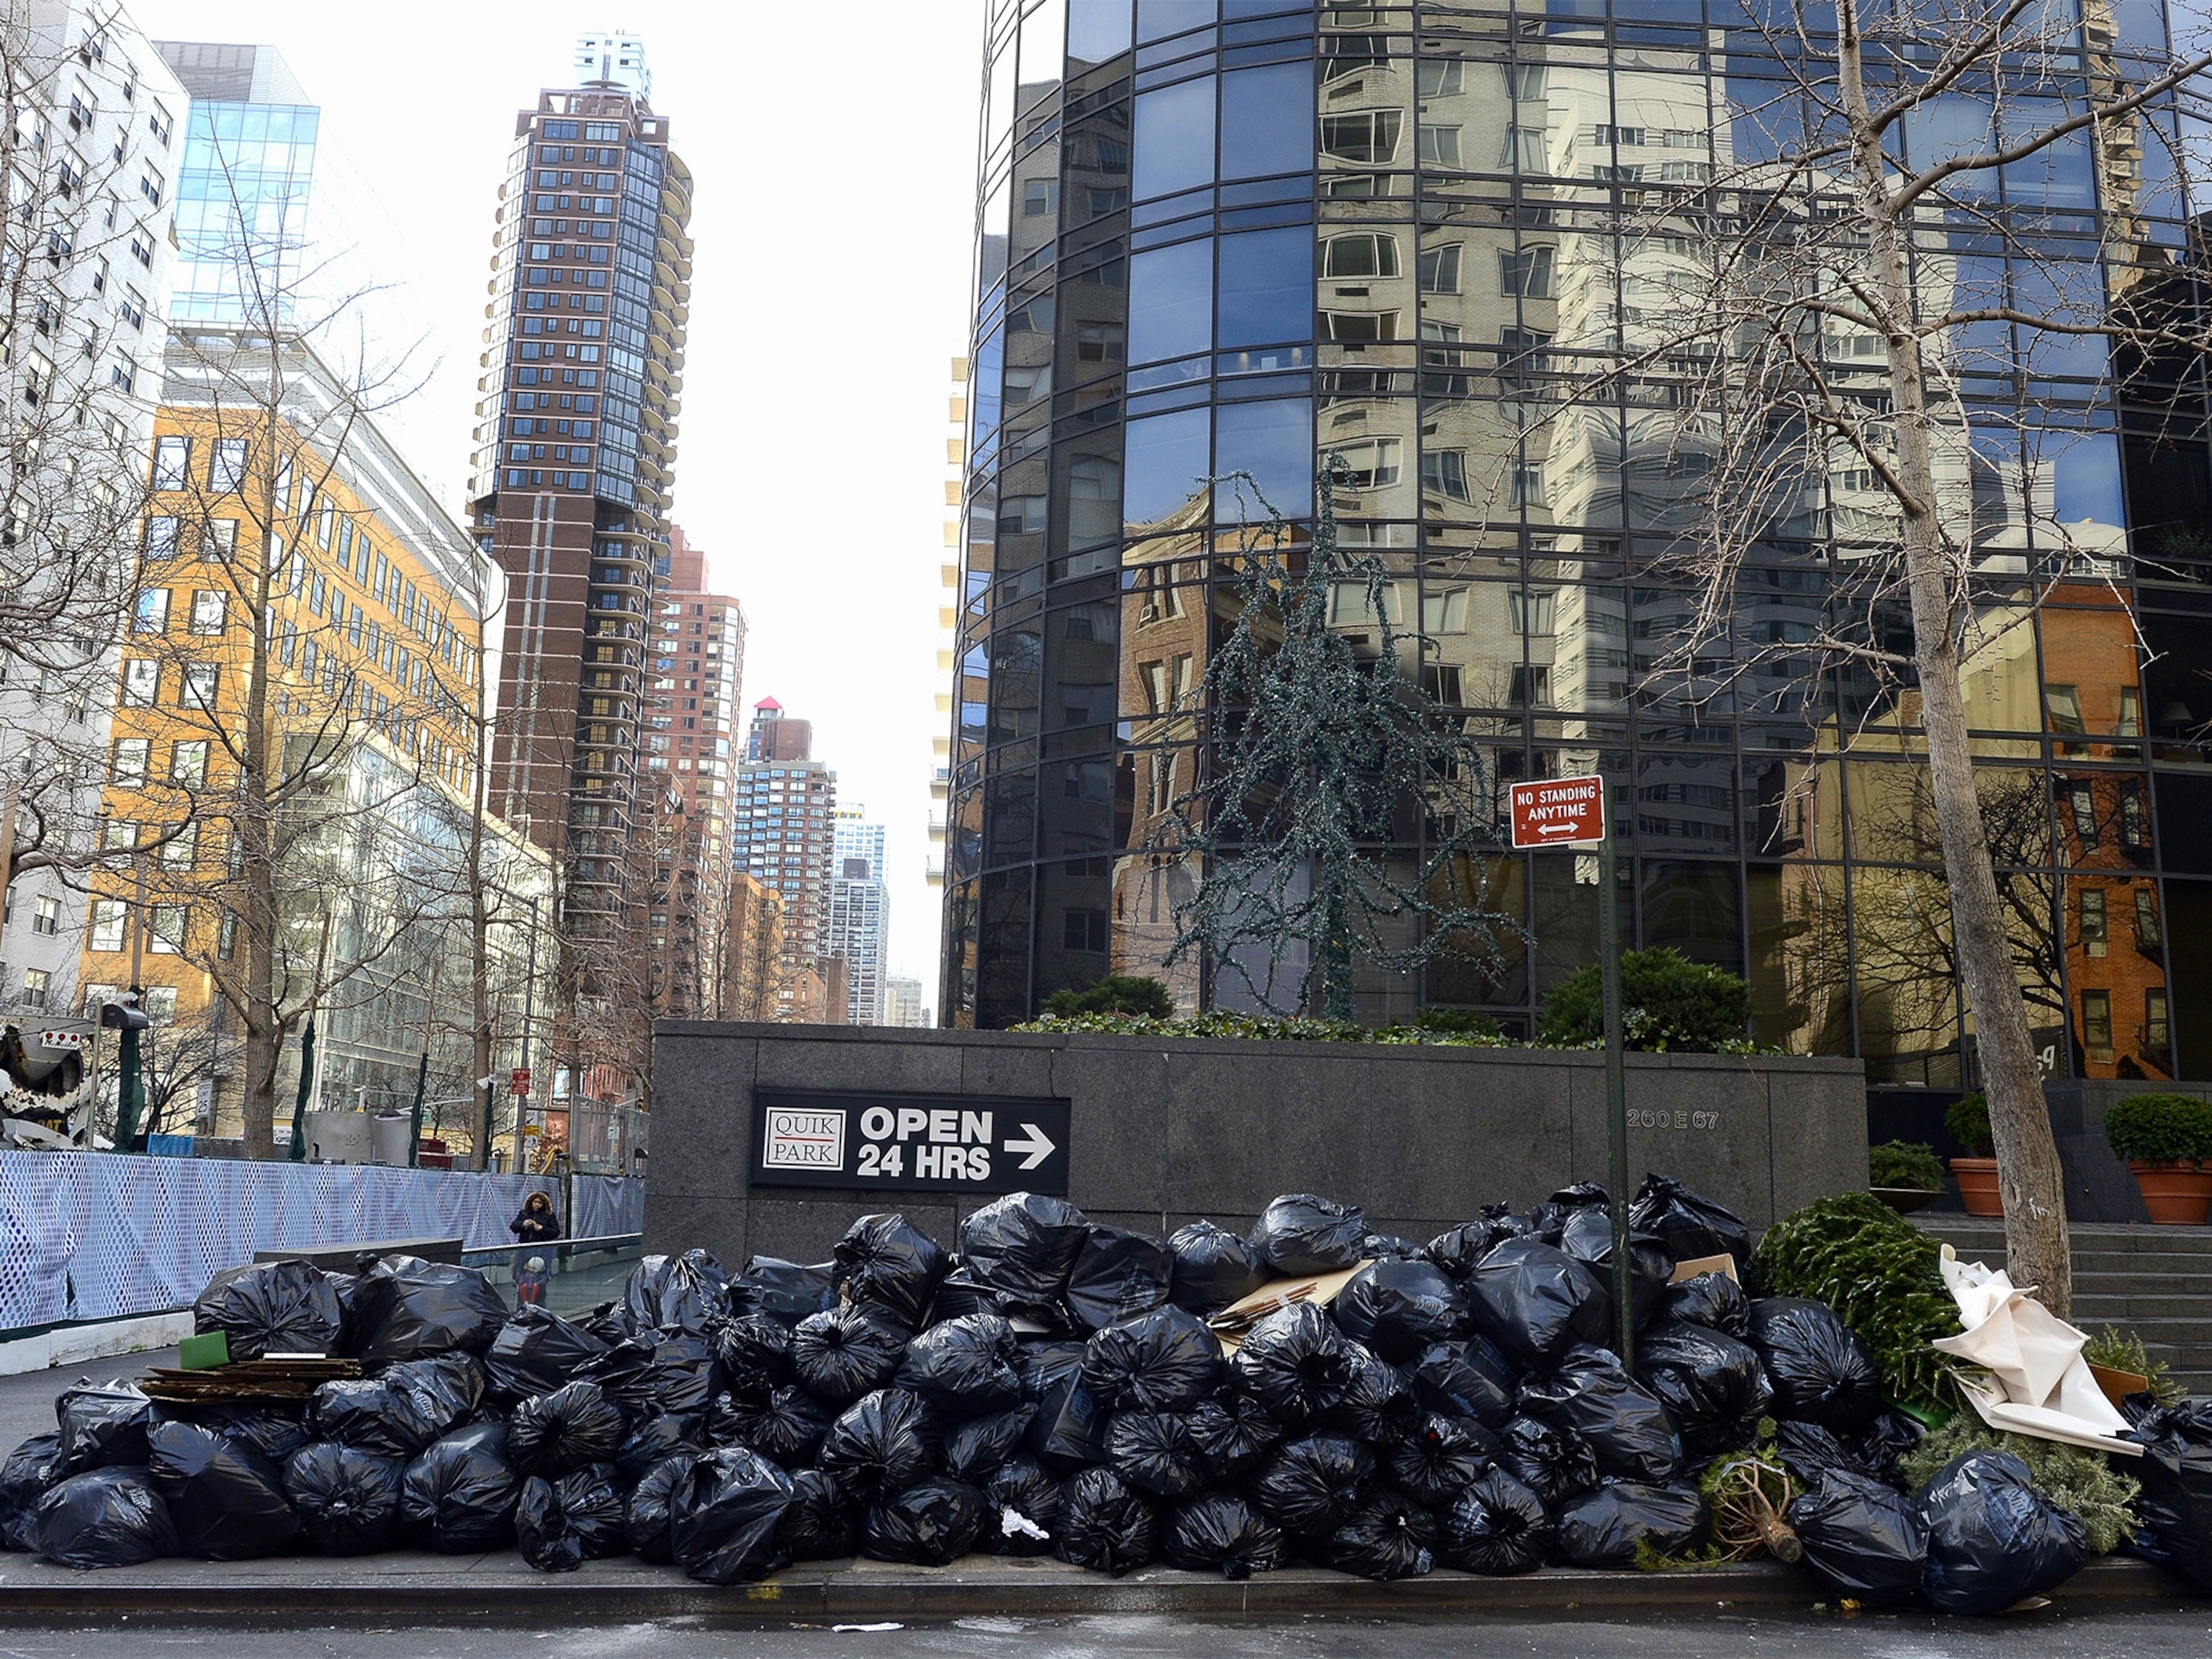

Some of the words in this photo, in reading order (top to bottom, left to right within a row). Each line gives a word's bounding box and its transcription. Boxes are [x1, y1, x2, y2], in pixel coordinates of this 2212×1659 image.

[1517, 792, 1534, 806] NO
[1539, 786, 1596, 804] STANDING
[1528, 803, 1588, 822] ANYTIME
[198, 1100, 208, 1112] 25
[775, 1115, 836, 1135] QUIK
[860, 1106, 993, 1144] OPEN
[1627, 1109, 1671, 1128] 260
[1674, 1110, 1688, 1129] E
[1692, 1110, 1719, 1130] 67
[773, 1143, 835, 1163] PARK
[857, 1144, 904, 1177] 24
[915, 1145, 991, 1181] HRS
